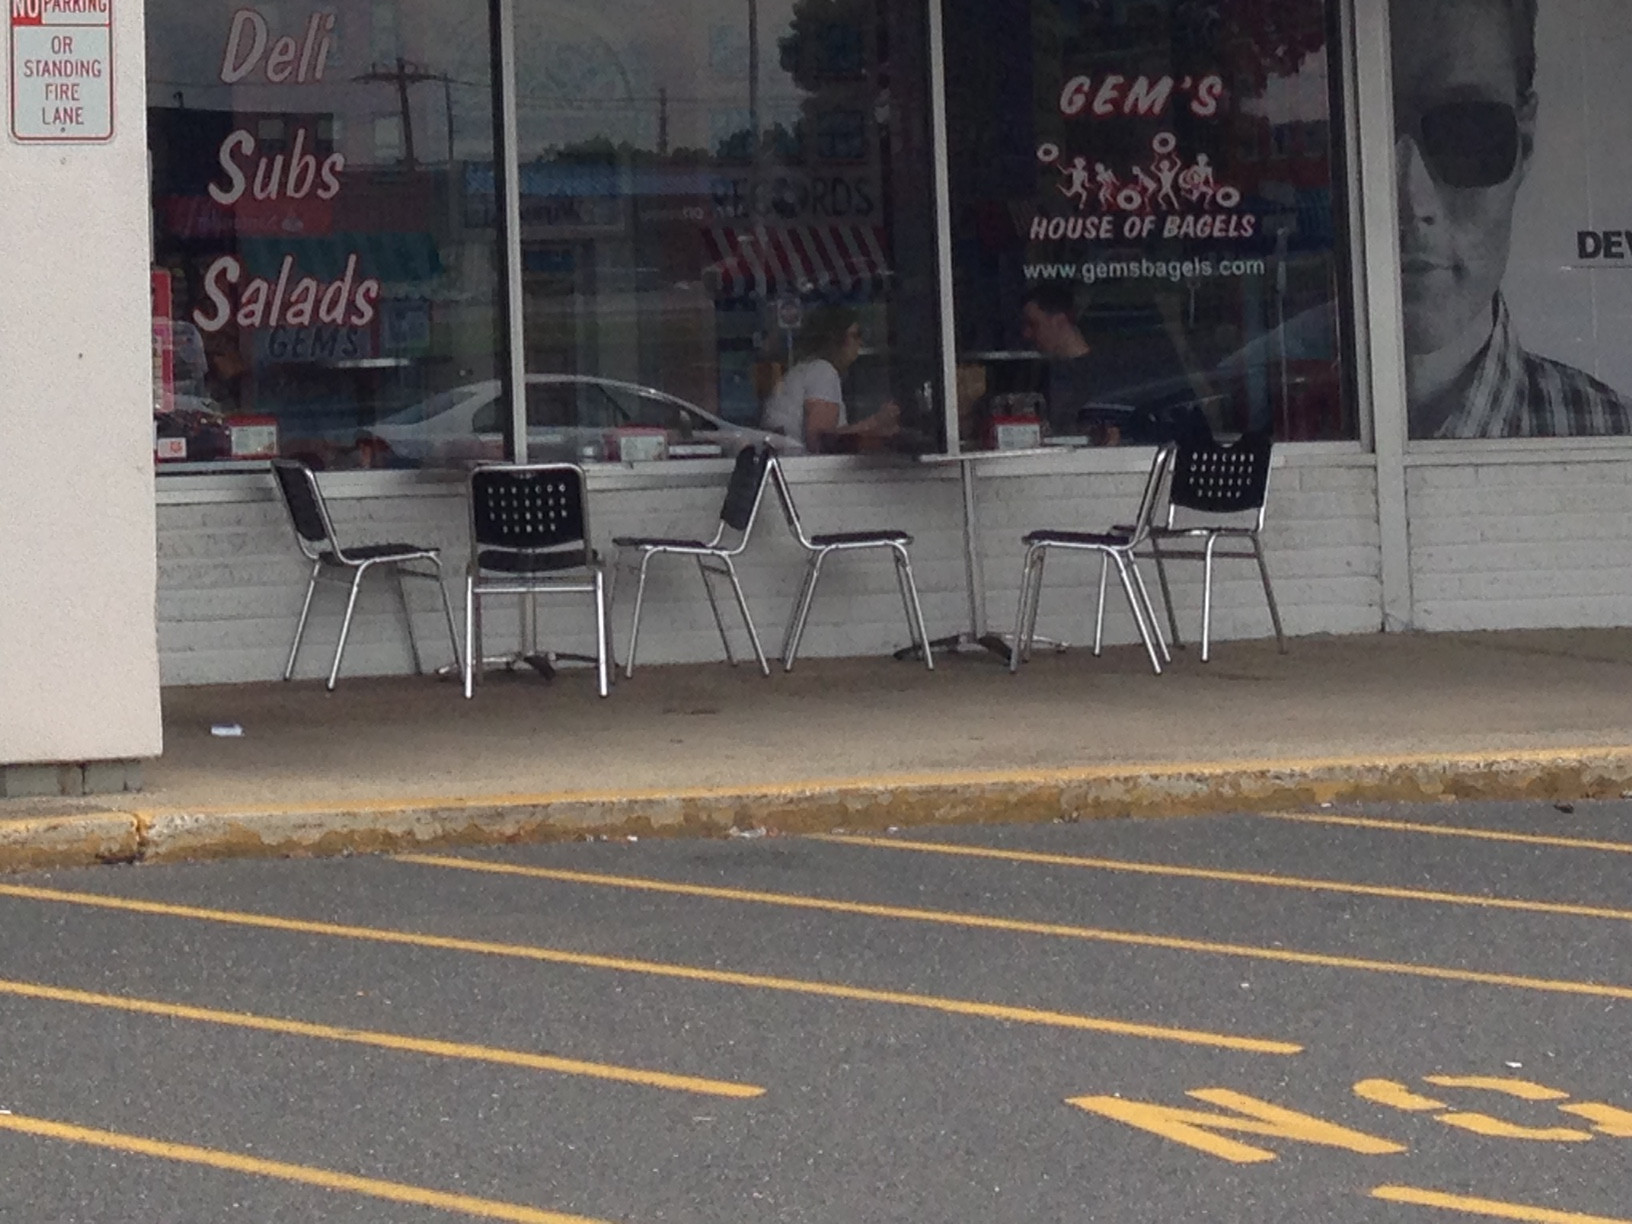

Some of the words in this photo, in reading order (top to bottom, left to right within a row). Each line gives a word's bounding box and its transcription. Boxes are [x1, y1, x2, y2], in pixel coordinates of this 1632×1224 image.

[50, 35, 73, 54] OR
[219, 8, 335, 84] Deli
[23, 59, 102, 78] STANDING
[44, 83, 81, 101] FIRE
[1058, 74, 1224, 117] GEM'S
[41, 107, 85, 125] LANE
[208, 129, 345, 205] Subs
[1029, 216, 1114, 240] HOUSE
[1123, 215, 1156, 239] OF
[1163, 213, 1256, 239] BAGELS
[1576, 229, 1632, 260] DE
[1022, 256, 1266, 284] www.gemsbagels.com
[193, 254, 379, 331] Salads
